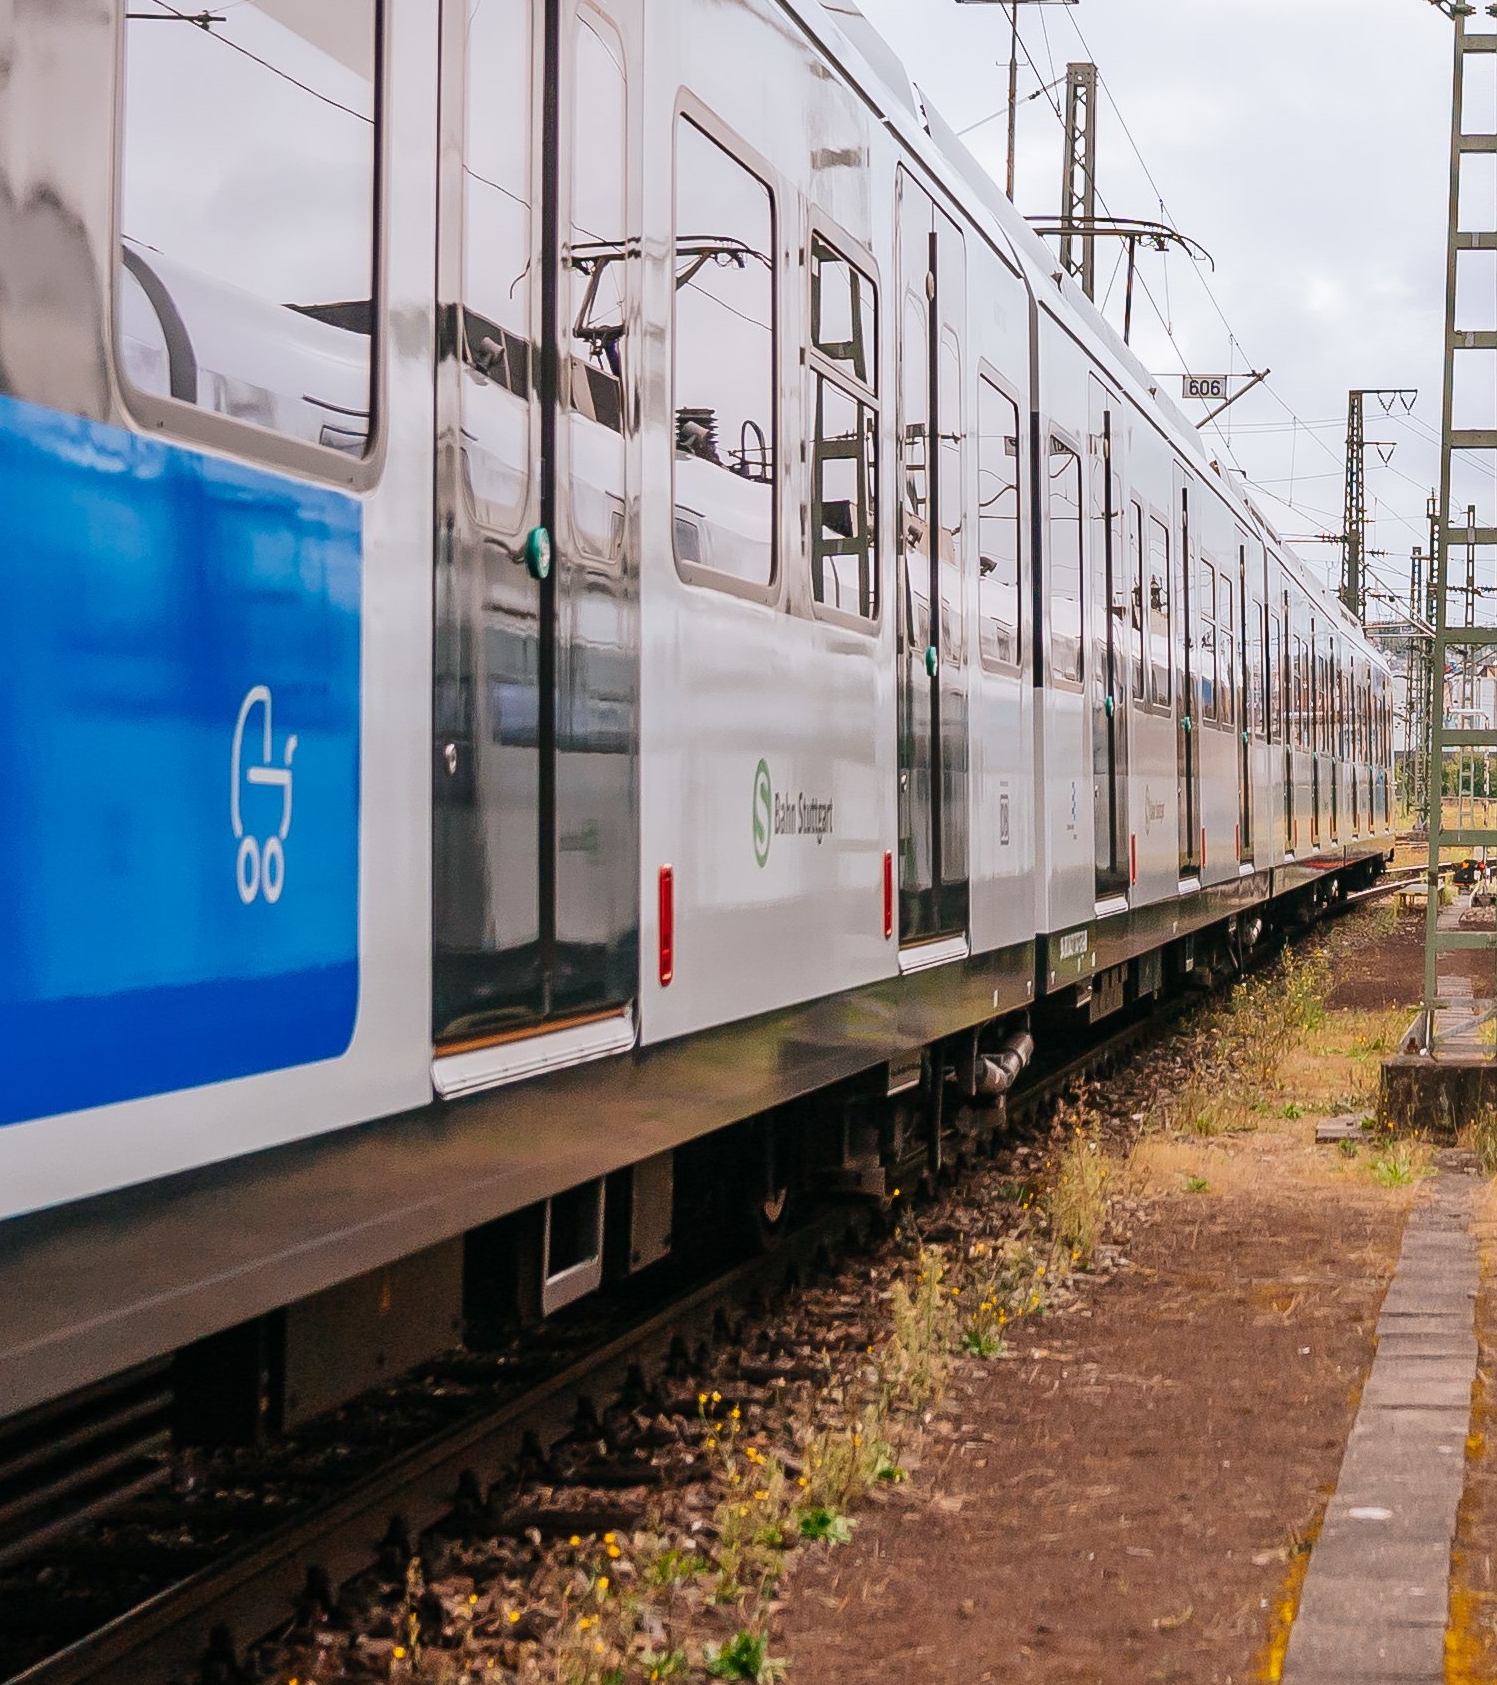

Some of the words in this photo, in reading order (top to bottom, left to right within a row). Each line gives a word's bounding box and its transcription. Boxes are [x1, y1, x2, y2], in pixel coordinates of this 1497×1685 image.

[1188, 379, 1221, 396] 606
[775, 791, 796, 834] Bahn
[798, 791, 833, 845] Stuttgart
